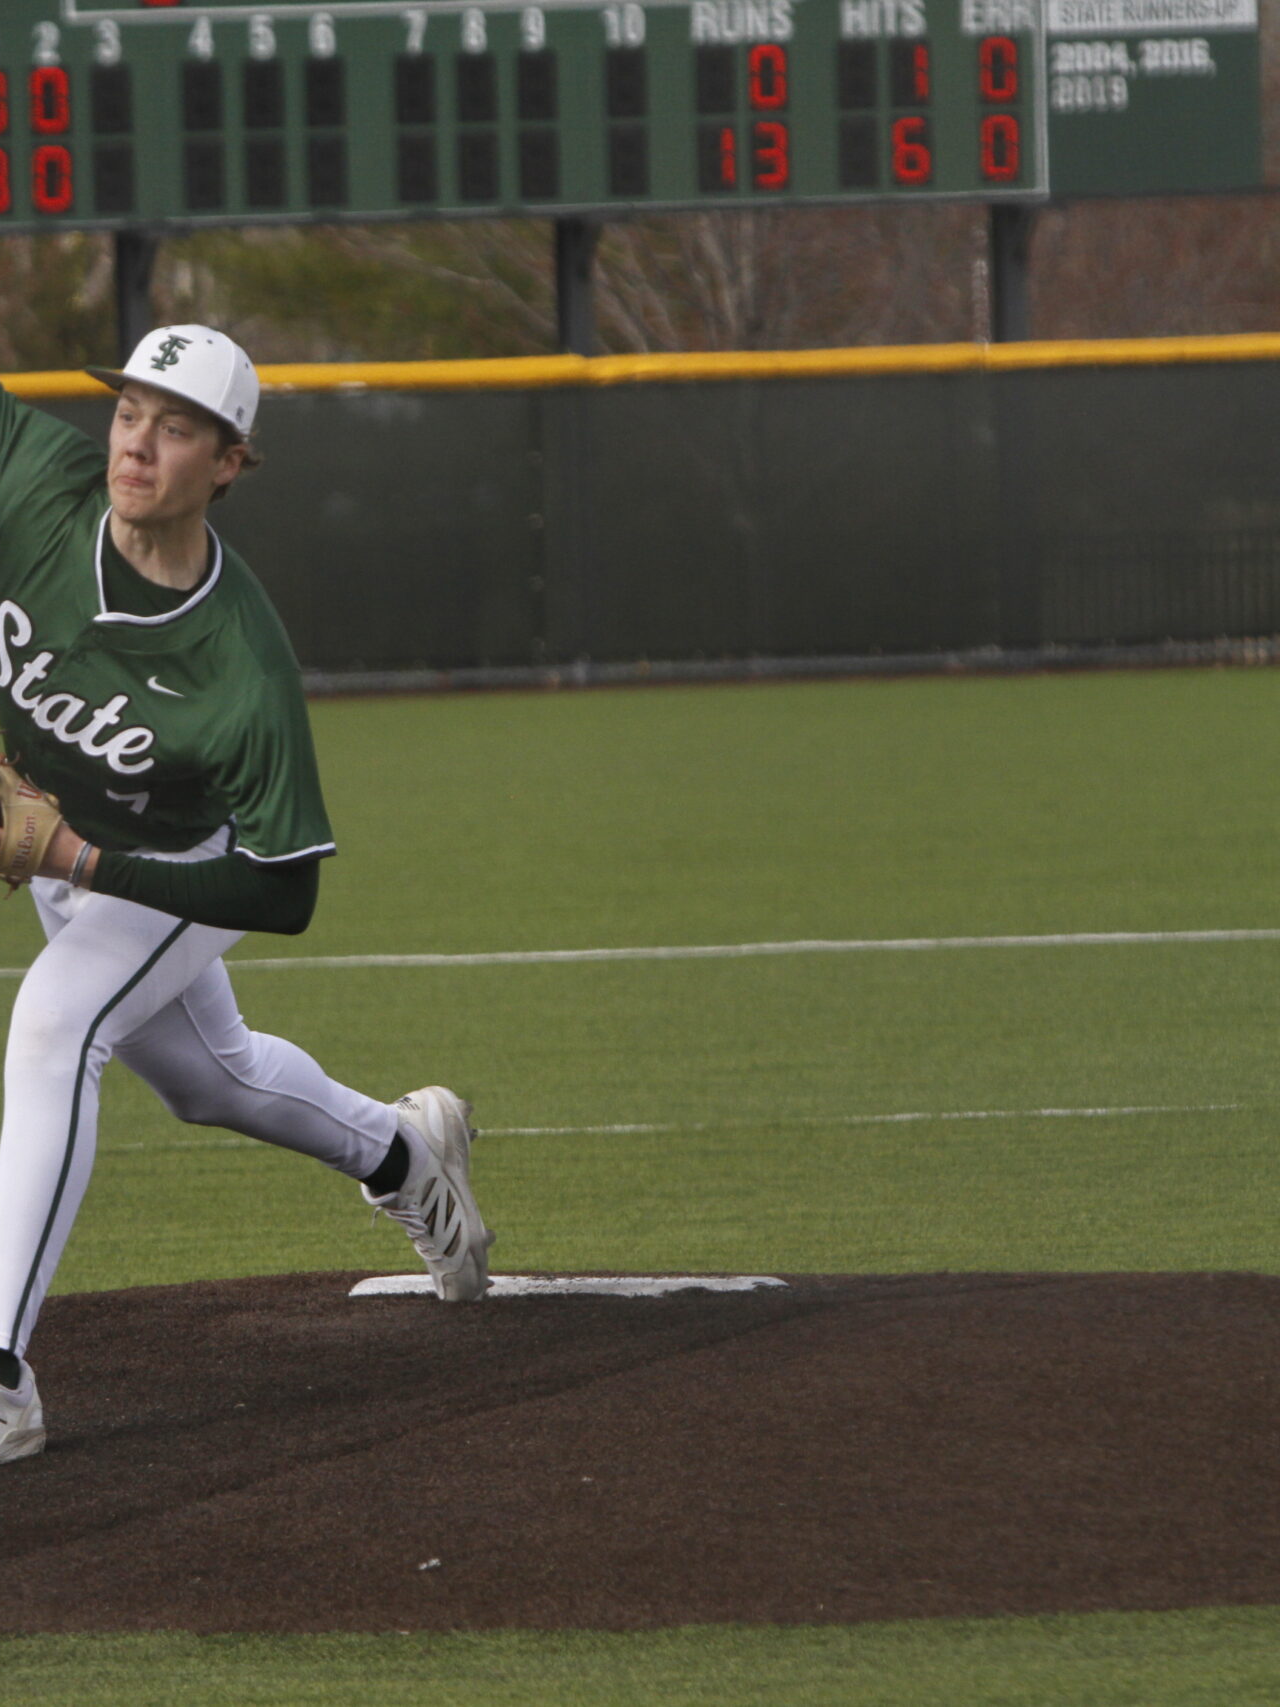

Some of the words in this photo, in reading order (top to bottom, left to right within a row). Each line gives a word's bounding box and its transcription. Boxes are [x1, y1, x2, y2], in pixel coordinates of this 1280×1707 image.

[33, 20, 60, 66] 2
[95, 19, 120, 66] 3
[188, 15, 214, 62] 4
[249, 14, 276, 60] 5
[309, 12, 335, 58] 6
[402, 9, 426, 55] 7
[462, 7, 487, 55] 8
[523, 6, 545, 53] 9
[601, 3, 645, 48] 10
[691, 0, 794, 42] RUNS
[839, 0, 927, 37] HITS
[29, 67, 69, 133] 0
[748, 44, 787, 110] 0
[913, 45, 929, 99] 1
[980, 37, 1017, 102] 0
[33, 145, 71, 213] 0
[722, 121, 789, 190] 13
[892, 117, 931, 184] 6
[981, 114, 1019, 181] 0
